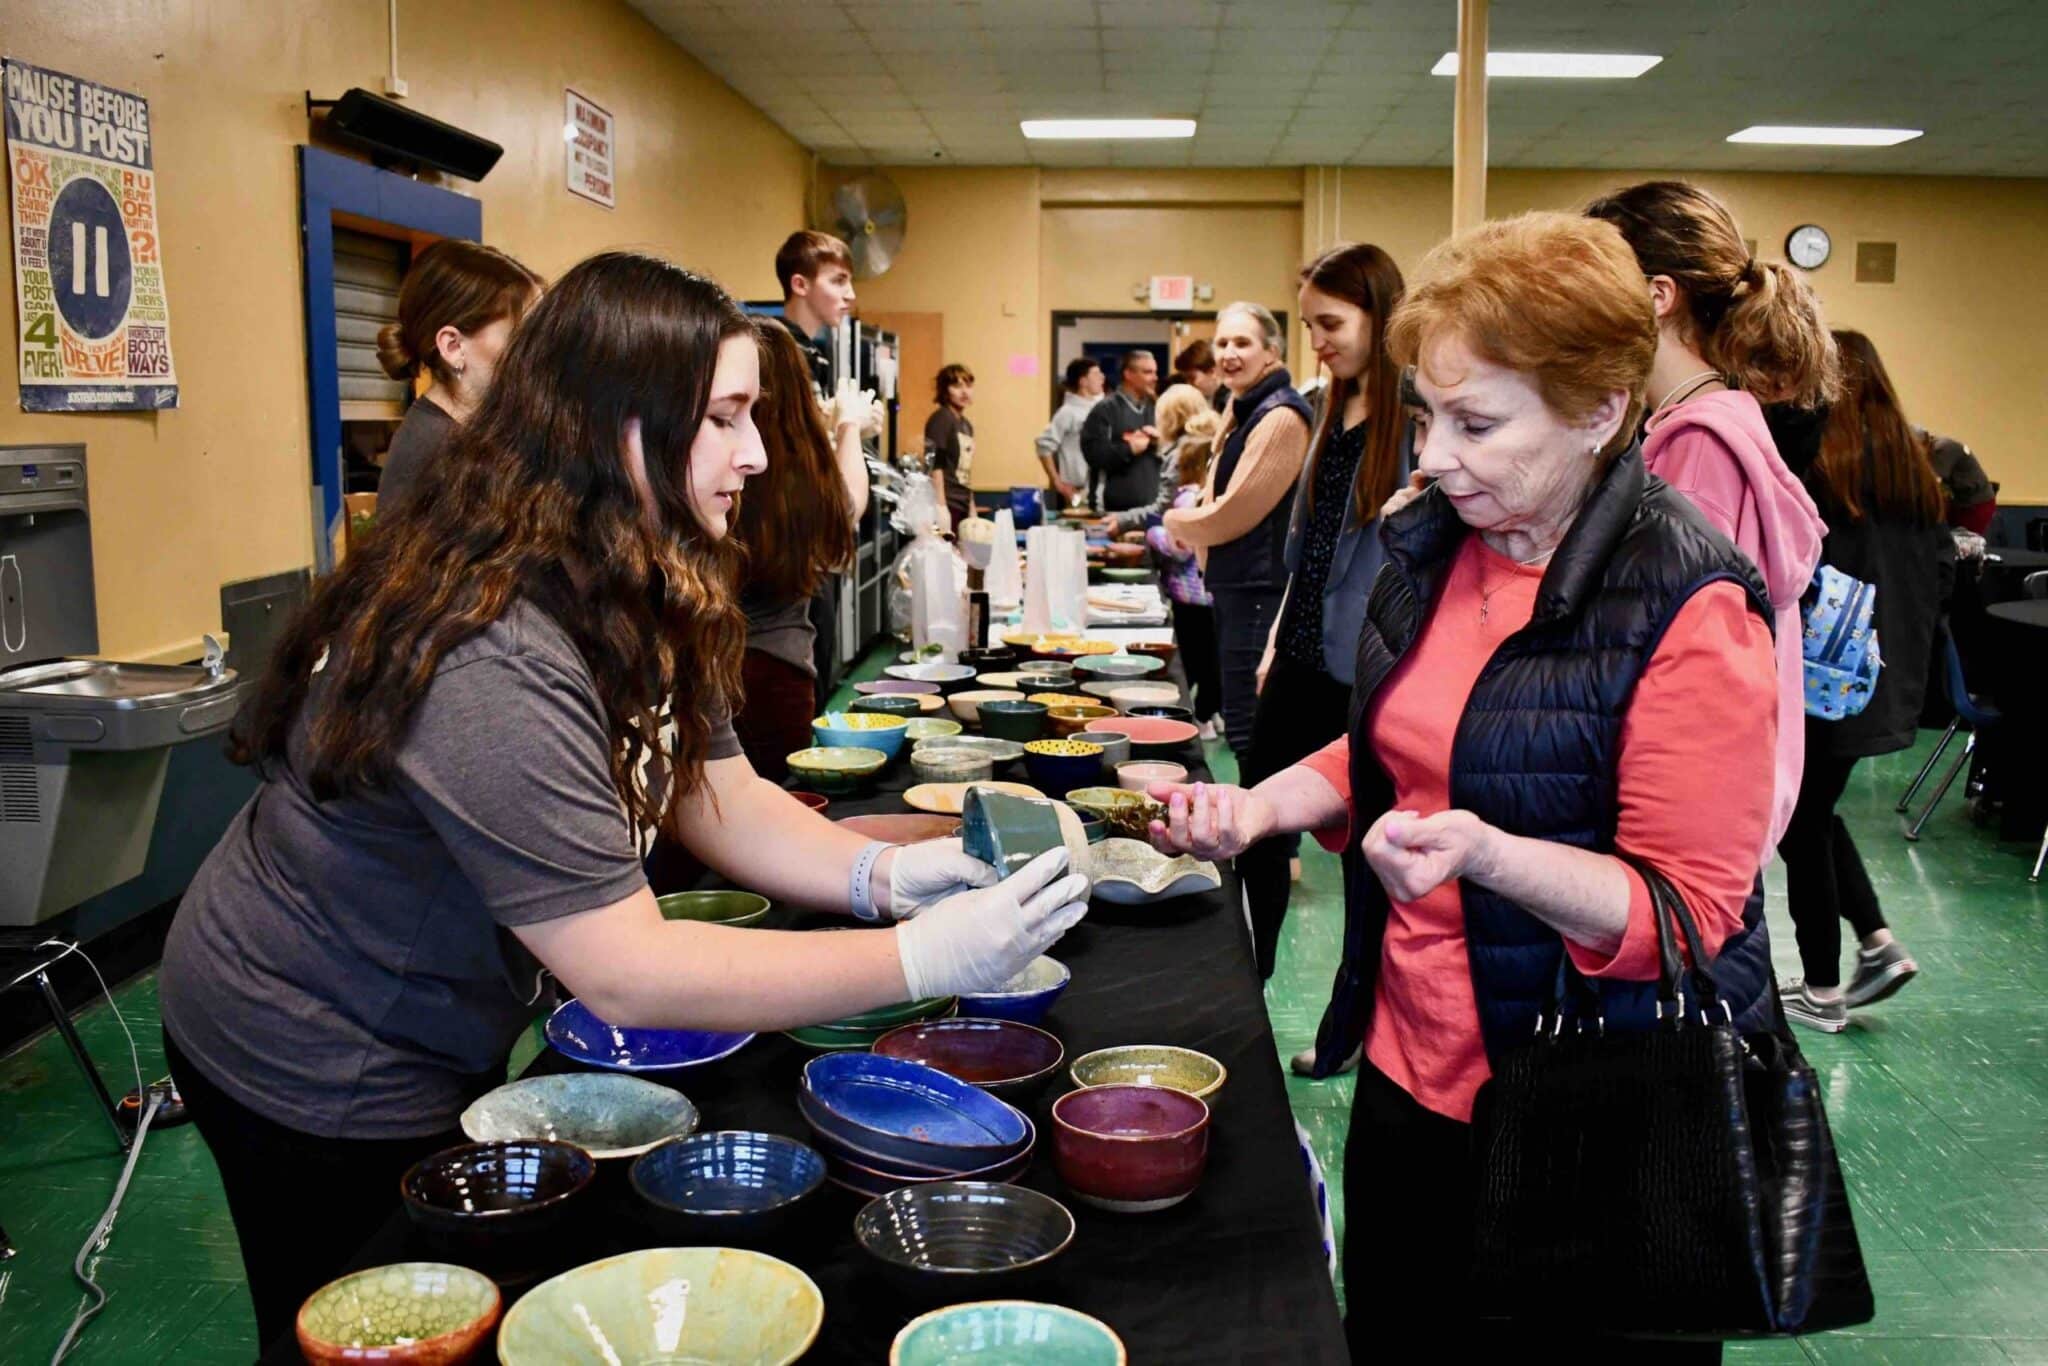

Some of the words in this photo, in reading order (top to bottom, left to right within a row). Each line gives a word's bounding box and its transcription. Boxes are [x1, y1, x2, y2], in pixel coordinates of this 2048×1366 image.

[6, 63, 76, 113] PAUSE
[80, 84, 148, 133] BEFORE
[9, 99, 76, 149] YOU
[80, 116, 149, 167] POST
[16, 157, 52, 188] OK
[123, 170, 134, 187] R
[137, 174, 150, 190] U
[18, 184, 53, 201] WITH
[123, 200, 152, 218] OR
[22, 269, 48, 285] YOUR
[23, 285, 54, 301] POST
[24, 301, 55, 311] CAN
[24, 312, 59, 349] 4
[62, 336, 126, 372] DRVE!
[127, 339, 168, 354] BOTH
[127, 354, 169, 374] WAYS
